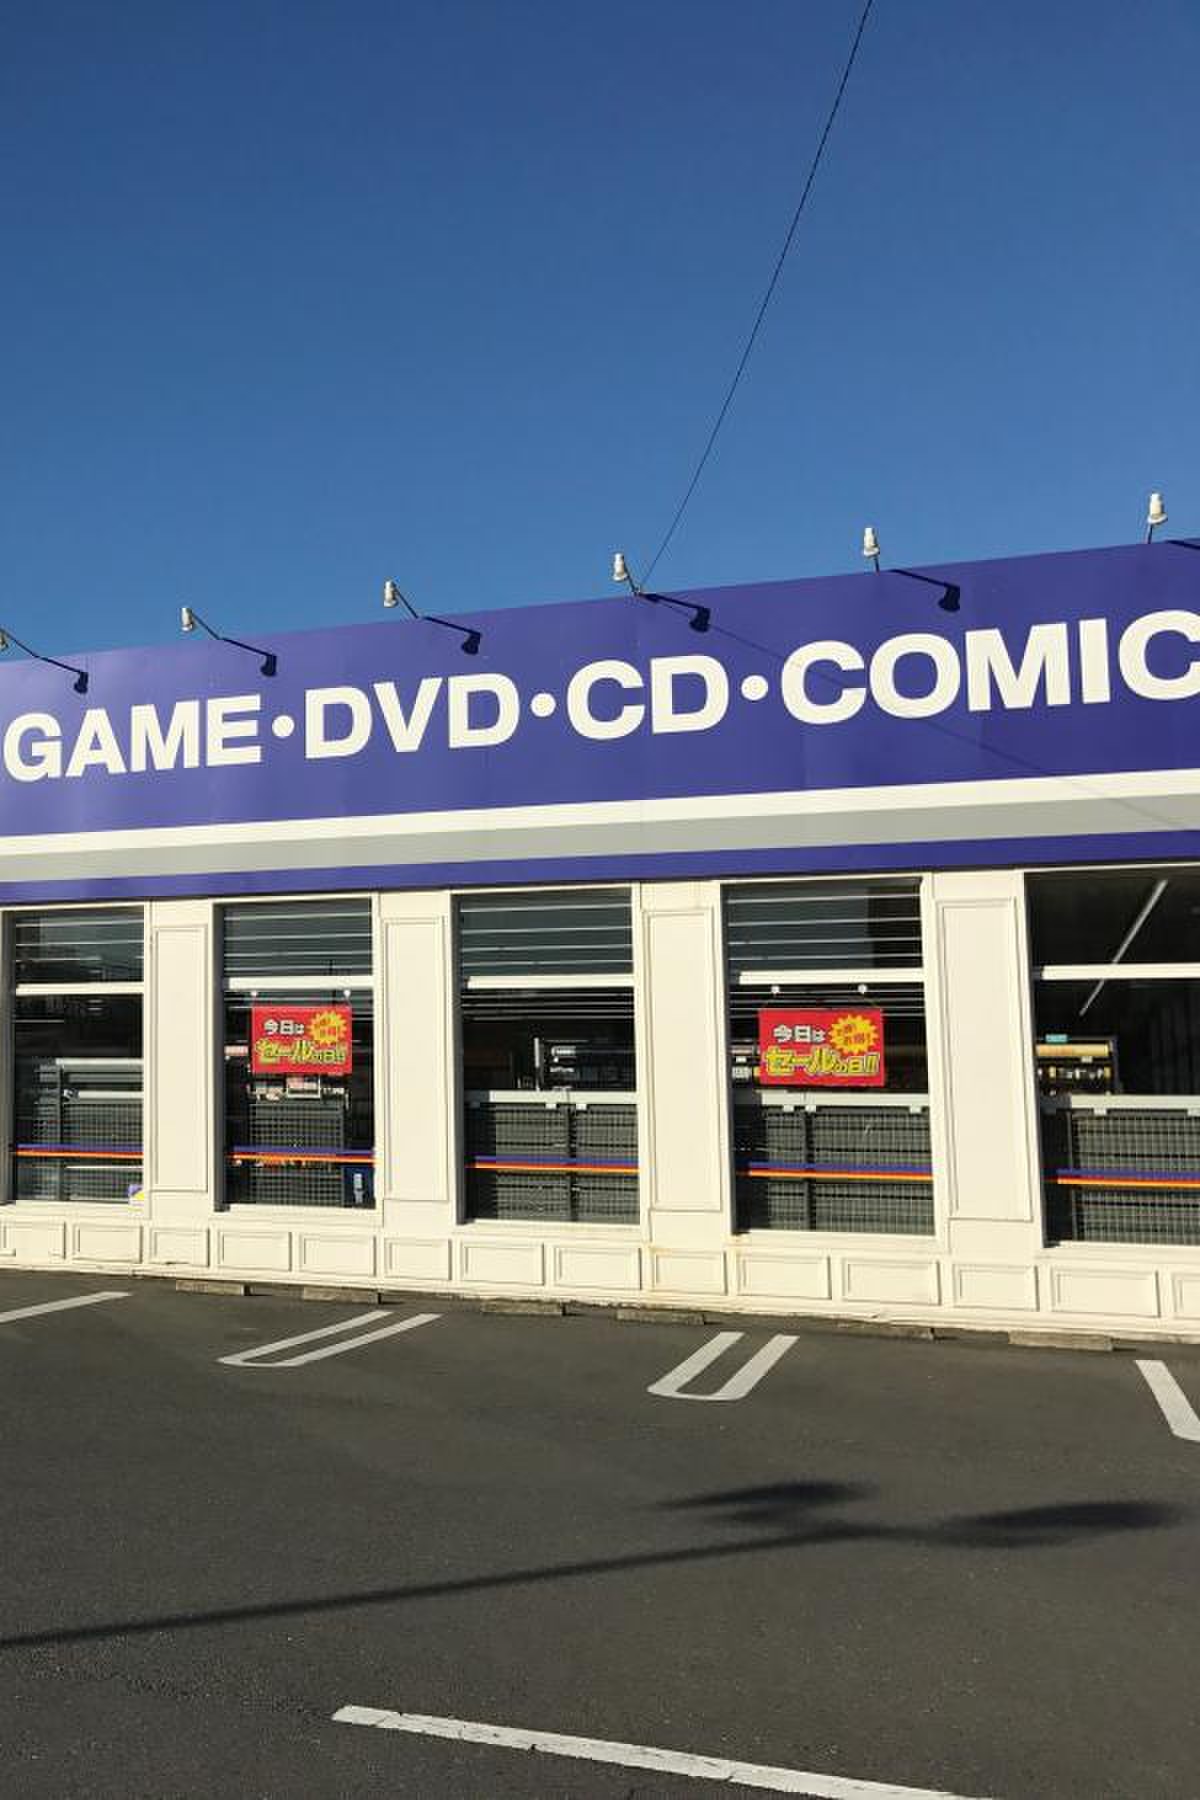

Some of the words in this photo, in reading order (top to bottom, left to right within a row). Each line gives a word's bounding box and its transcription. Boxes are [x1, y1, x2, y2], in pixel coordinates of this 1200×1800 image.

[264, 1019, 304, 1035] 今日は
[773, 1025, 826, 1042] 今日は
